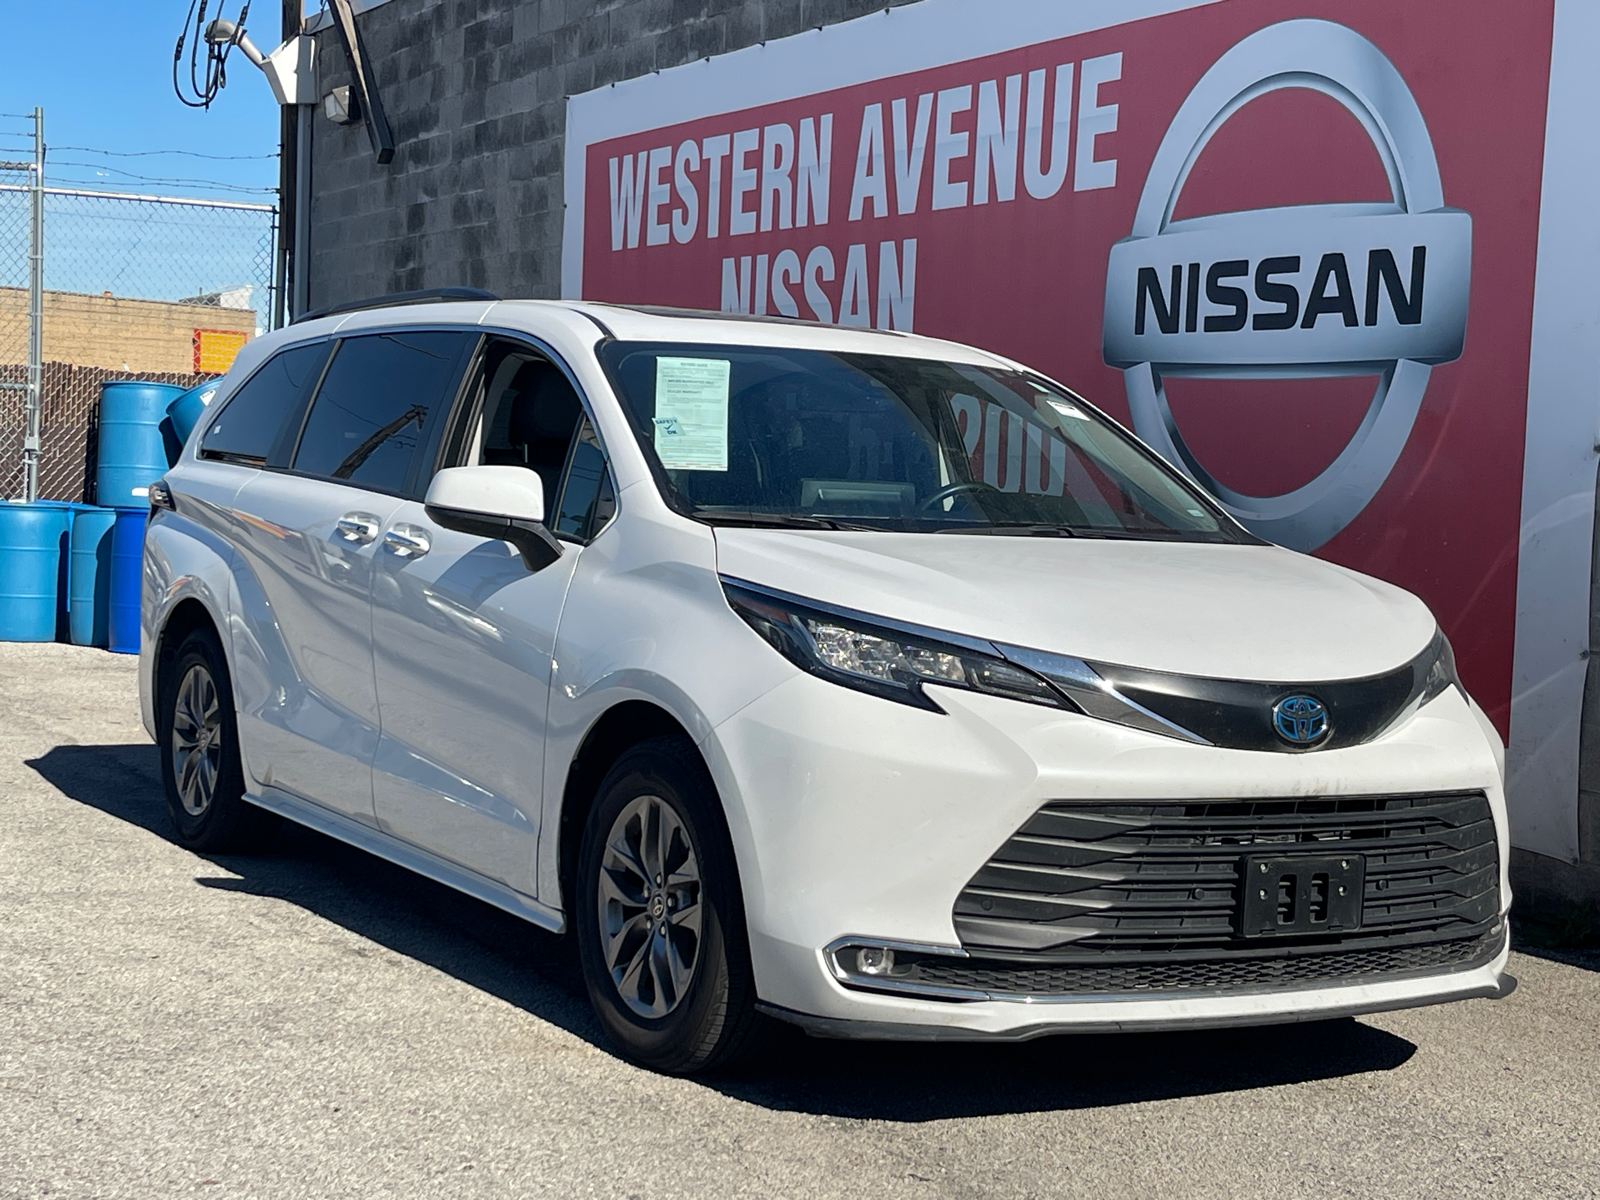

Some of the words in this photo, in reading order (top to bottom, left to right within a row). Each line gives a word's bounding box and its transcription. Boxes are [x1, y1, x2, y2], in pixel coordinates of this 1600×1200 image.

[609, 113, 833, 251] WESTERN
[848, 52, 1123, 221] AVENUE
[721, 238, 917, 334] NISSAN
[1134, 246, 1426, 335] NISSAN
